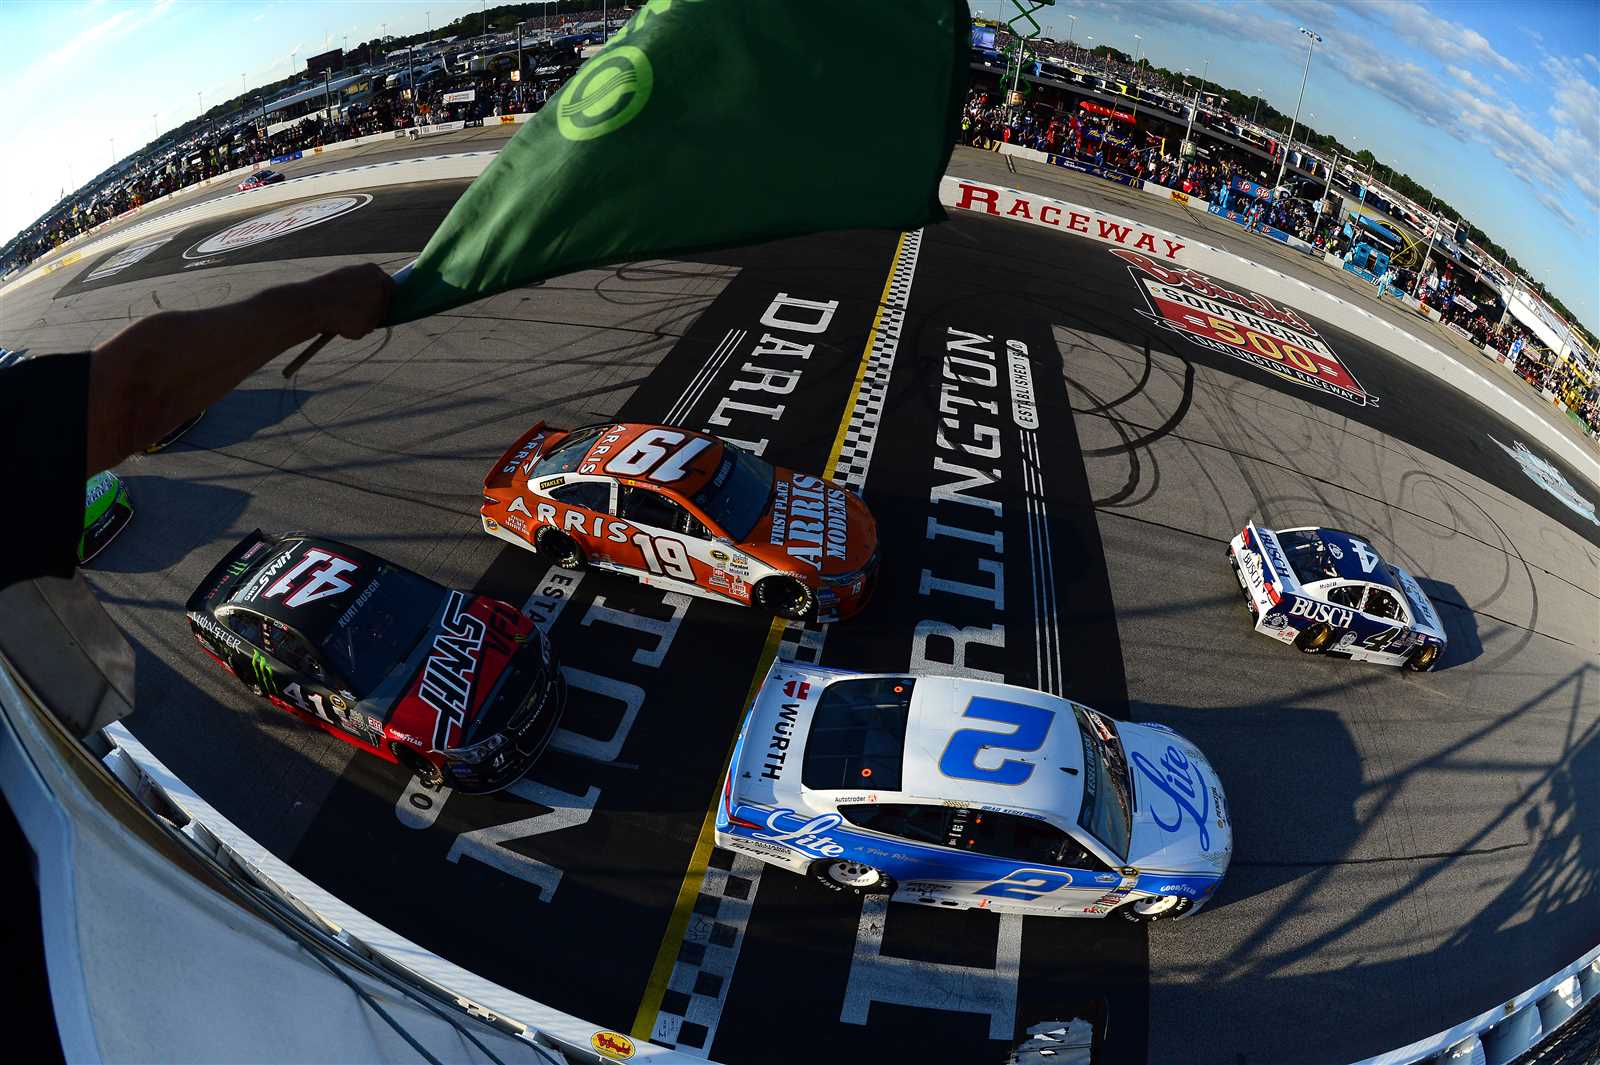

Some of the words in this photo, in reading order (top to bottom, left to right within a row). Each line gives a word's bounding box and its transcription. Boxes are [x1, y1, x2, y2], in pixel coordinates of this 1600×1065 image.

[1256, 188, 1270, 200] STP
[955, 183, 1186, 259] RACEWAY
[1160, 286, 1329, 354] SOUTHERN
[1207, 316, 1319, 374] 500
[1197, 338, 1292, 376] DARLINGTON
[1297, 371, 1355, 401] RACEWAY
[1014, 363, 1034, 423] ESTABLISHED
[503, 431, 545, 474] ARRIS
[580, 424, 626, 474] ARRIS
[602, 427, 712, 483] 19
[541, 478, 565, 489] STANLEY
[775, 480, 790, 511] PLACE
[508, 496, 630, 543] ARRIS
[770, 512, 787, 546] FIRST
[787, 473, 826, 572] ARRIS
[826, 488, 848, 561] MODEMS
[261, 547, 361, 608] 41
[632, 532, 697, 581] 19
[1243, 551, 1263, 589] BUSCH
[1259, 533, 1290, 579] BUSCH
[1348, 538, 1380, 574] 4
[850, 580, 861, 594] 19
[191, 612, 242, 655] MONSTER
[337, 601, 361, 629] KURT
[1289, 596, 1355, 629] BUSCH
[1362, 625, 1402, 652] 4
[418, 590, 487, 751] HAAS
[840, 326, 1023, 1041] DRLINGTON
[284, 682, 335, 724] 41
[389, 728, 423, 747] GOODYEAR
[491, 753, 505, 768] 41
[760, 703, 800, 781] WÜRTH
[938, 695, 1057, 787] 2
[835, 795, 866, 803] Autotrader
[1131, 744, 1211, 852] Lite
[752, 807, 845, 860] Lite
[974, 868, 1073, 902] 2
[1159, 883, 1197, 895] GOODYEAR
